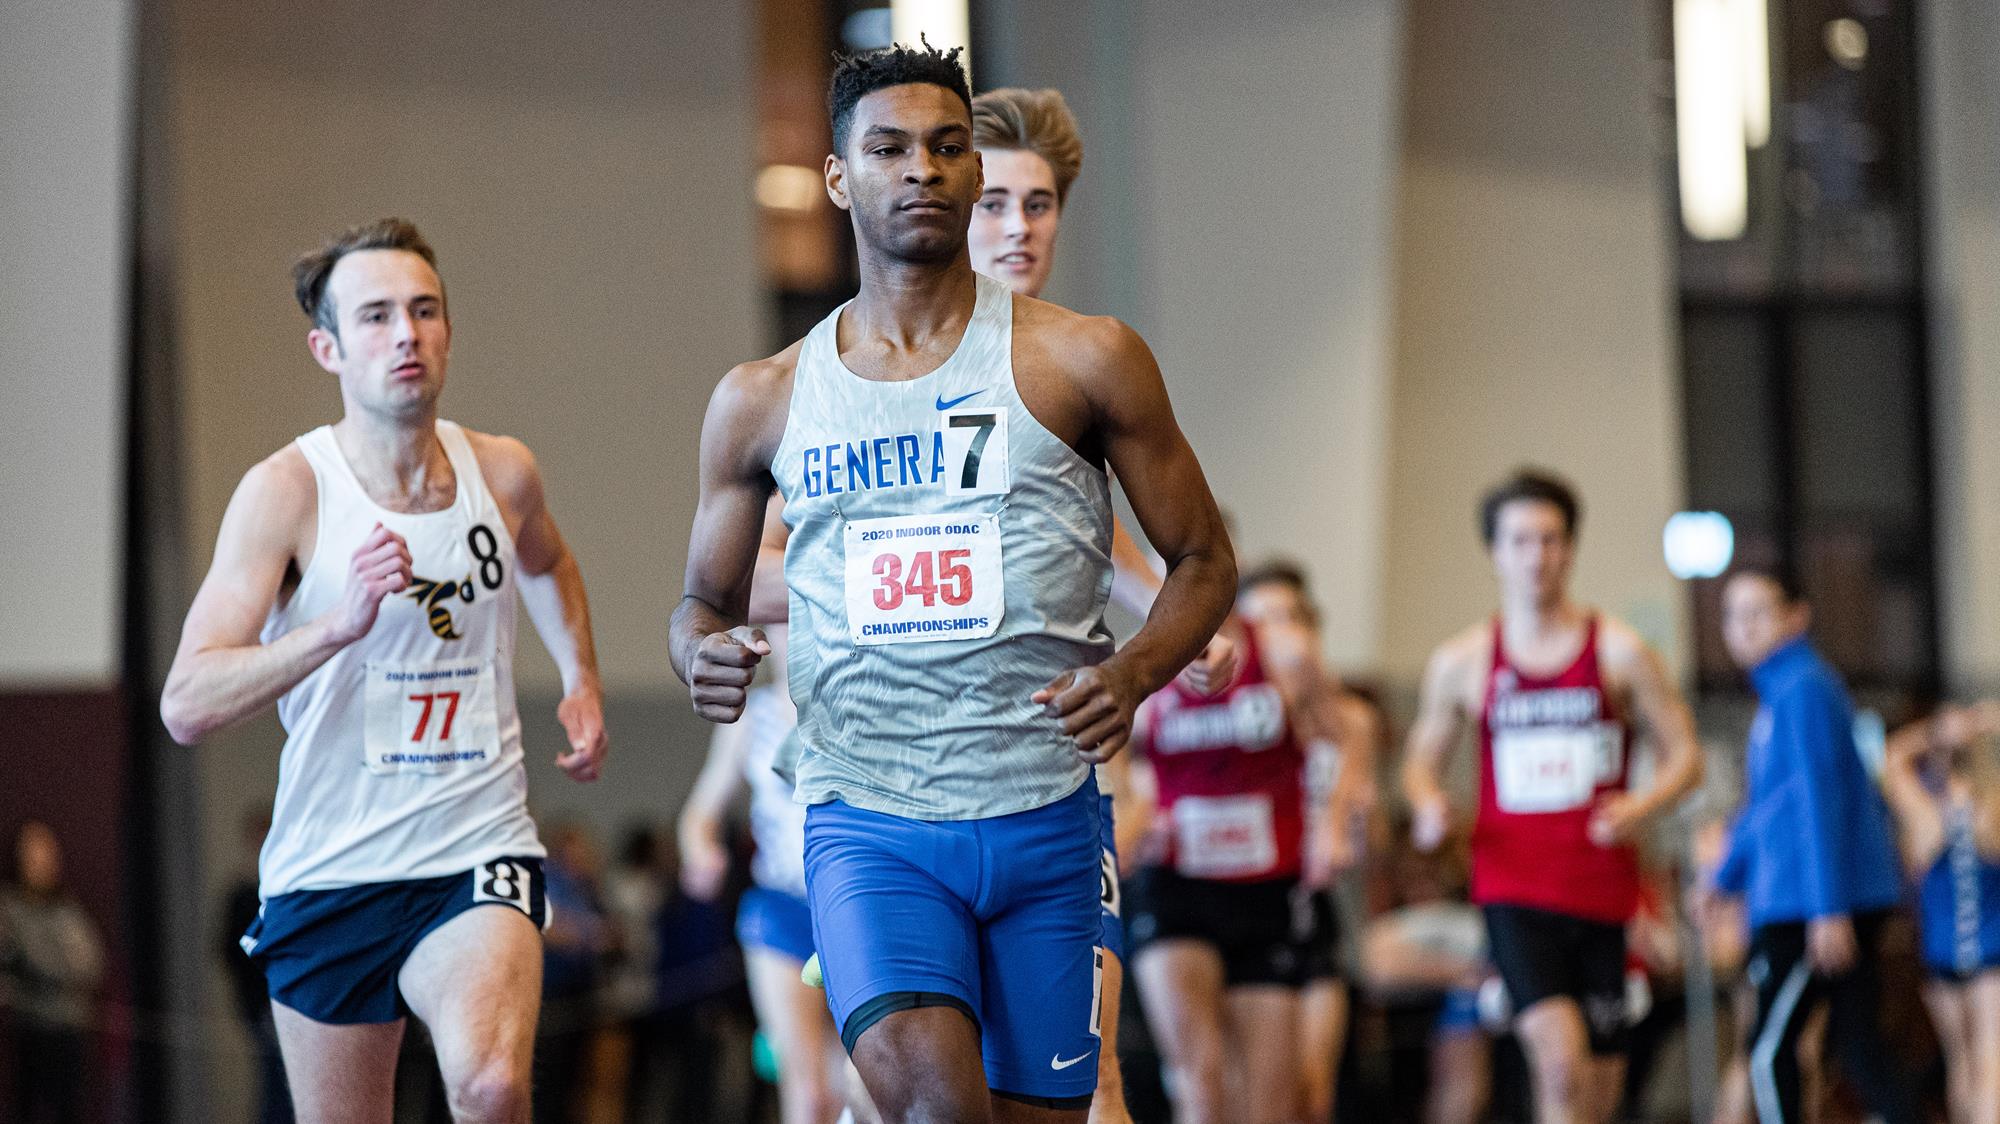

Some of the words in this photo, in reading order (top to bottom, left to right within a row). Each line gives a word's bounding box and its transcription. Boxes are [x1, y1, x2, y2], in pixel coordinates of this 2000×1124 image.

[949, 413, 997, 489] 7
[467, 524, 503, 590] 8
[862, 529, 893, 541] 2020
[896, 526, 941, 538] INDOOR
[944, 524, 980, 535] ODAC
[872, 549, 973, 611] 345
[862, 617, 989, 636] CHAMPIONSHIPS
[409, 691, 460, 742] 77
[482, 858, 520, 900] 8
